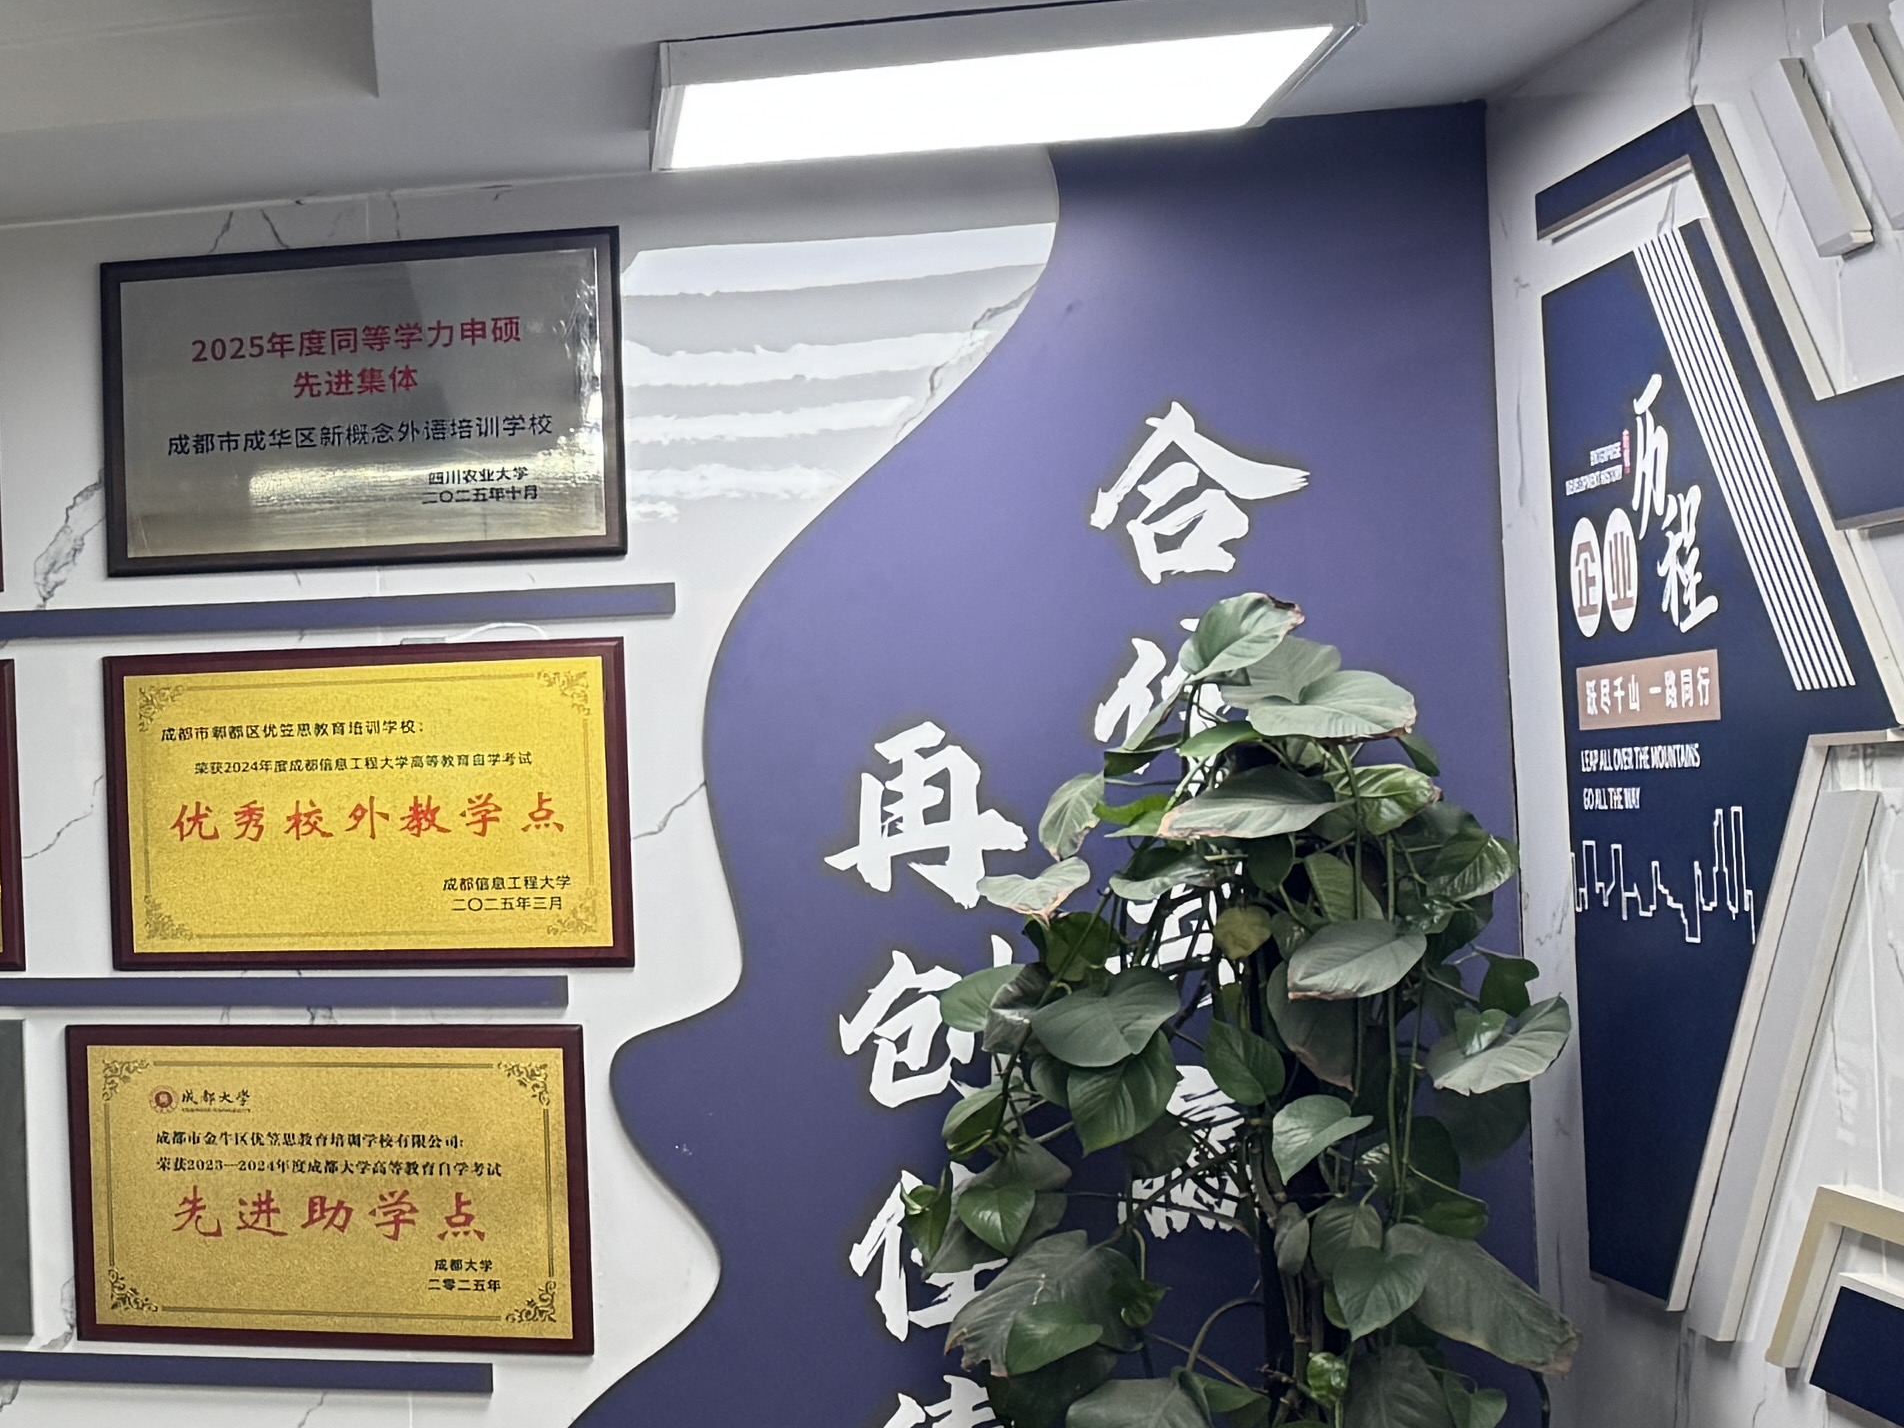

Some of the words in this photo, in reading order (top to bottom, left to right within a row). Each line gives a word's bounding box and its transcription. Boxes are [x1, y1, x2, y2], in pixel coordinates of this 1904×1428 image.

[191, 315, 522, 364] 2025年度同等学力申硕
[293, 364, 419, 400] 先进集体
[167, 412, 553, 457] 成都市成华区新概念外语培训学校
[428, 466, 529, 486] 四川农业大学
[1649, 666, 1710, 708] 一路同行
[194, 751, 533, 776] 荣获2024年度成都信息工程大学高等教育自学考试
[1634, 746, 1650, 770] THE
[1608, 787, 1623, 810] THE
[169, 791, 565, 843] 优秀校外教学点
[442, 874, 572, 892] 成都信息工程大学
[172, 1184, 487, 1242] 先进助学点
[434, 1257, 493, 1274] 成都大学
[427, 1276, 502, 1293] 二零二五年
